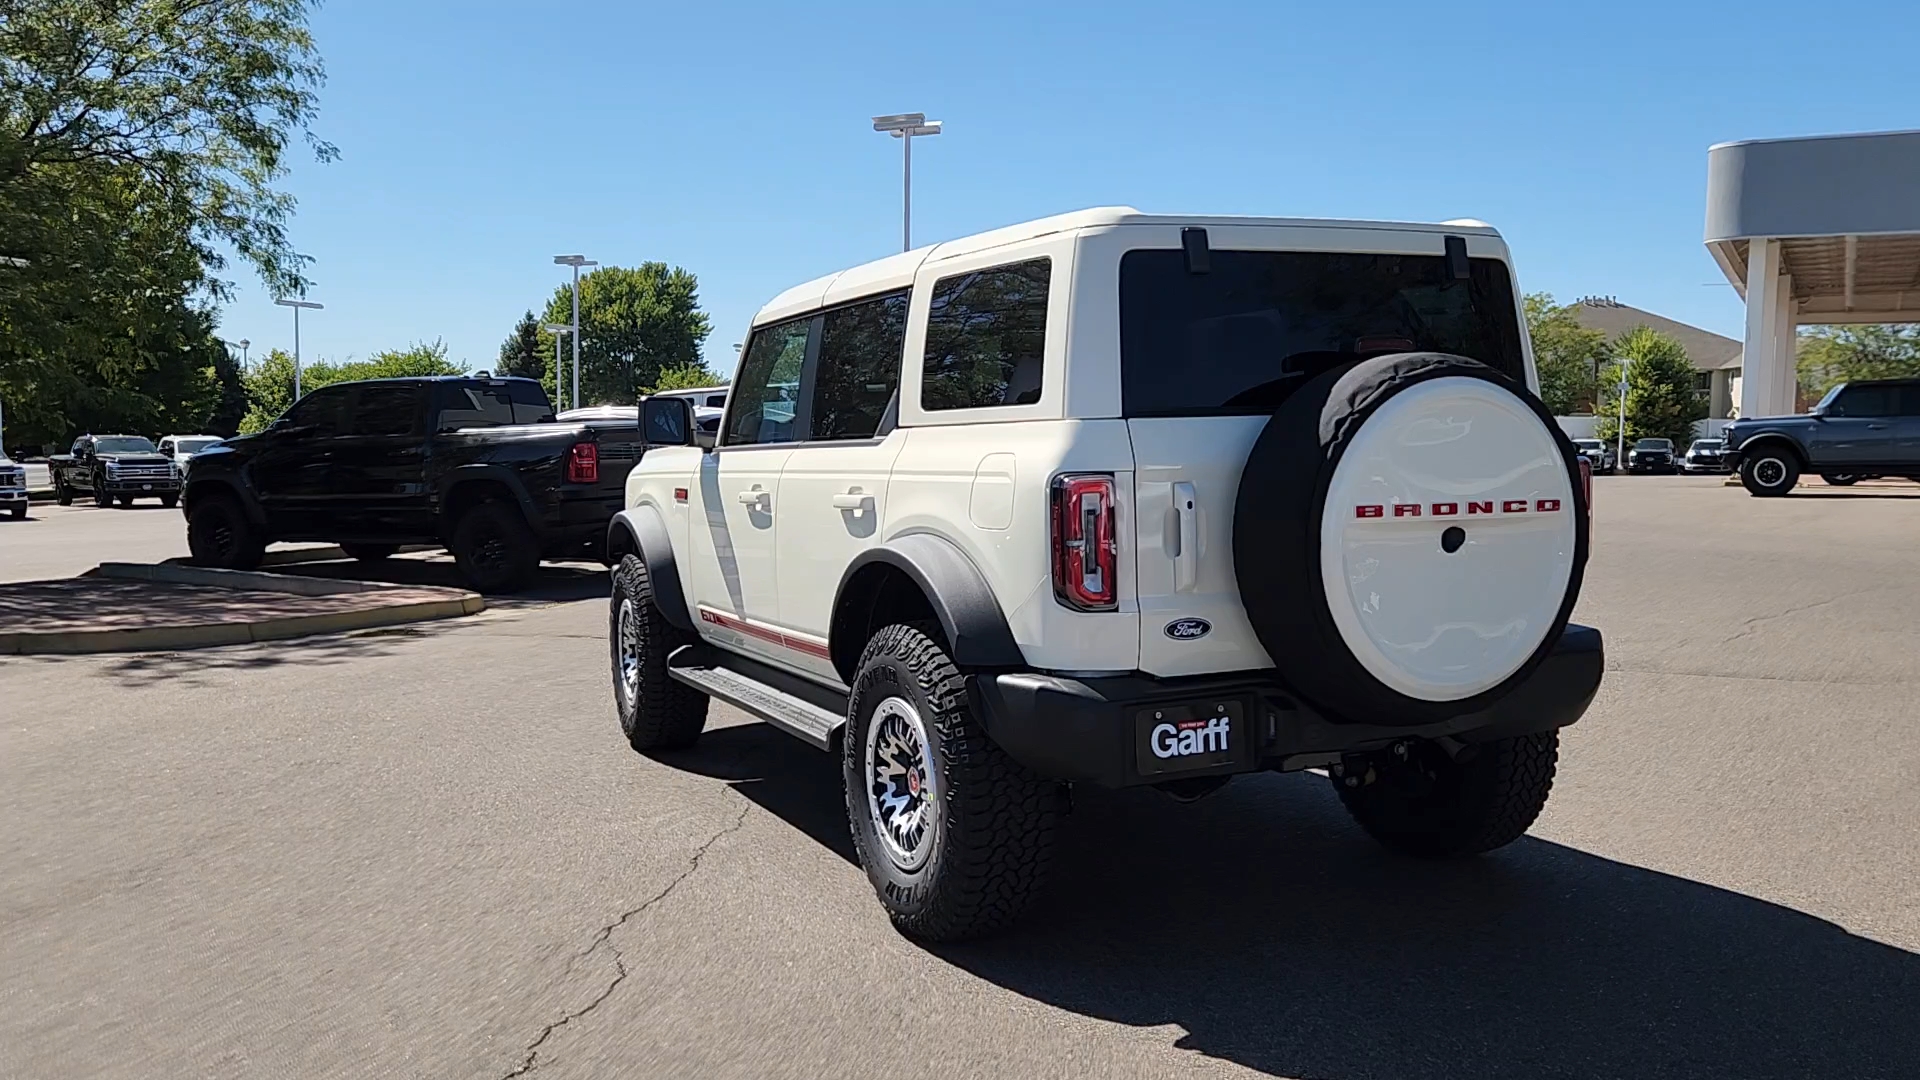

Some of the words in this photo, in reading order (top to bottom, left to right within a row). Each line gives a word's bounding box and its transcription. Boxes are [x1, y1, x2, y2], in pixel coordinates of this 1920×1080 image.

[1355, 499, 1561, 518] BRONCO
[1173, 621, 1204, 638] Ford
[1151, 717, 1230, 759] Garff
